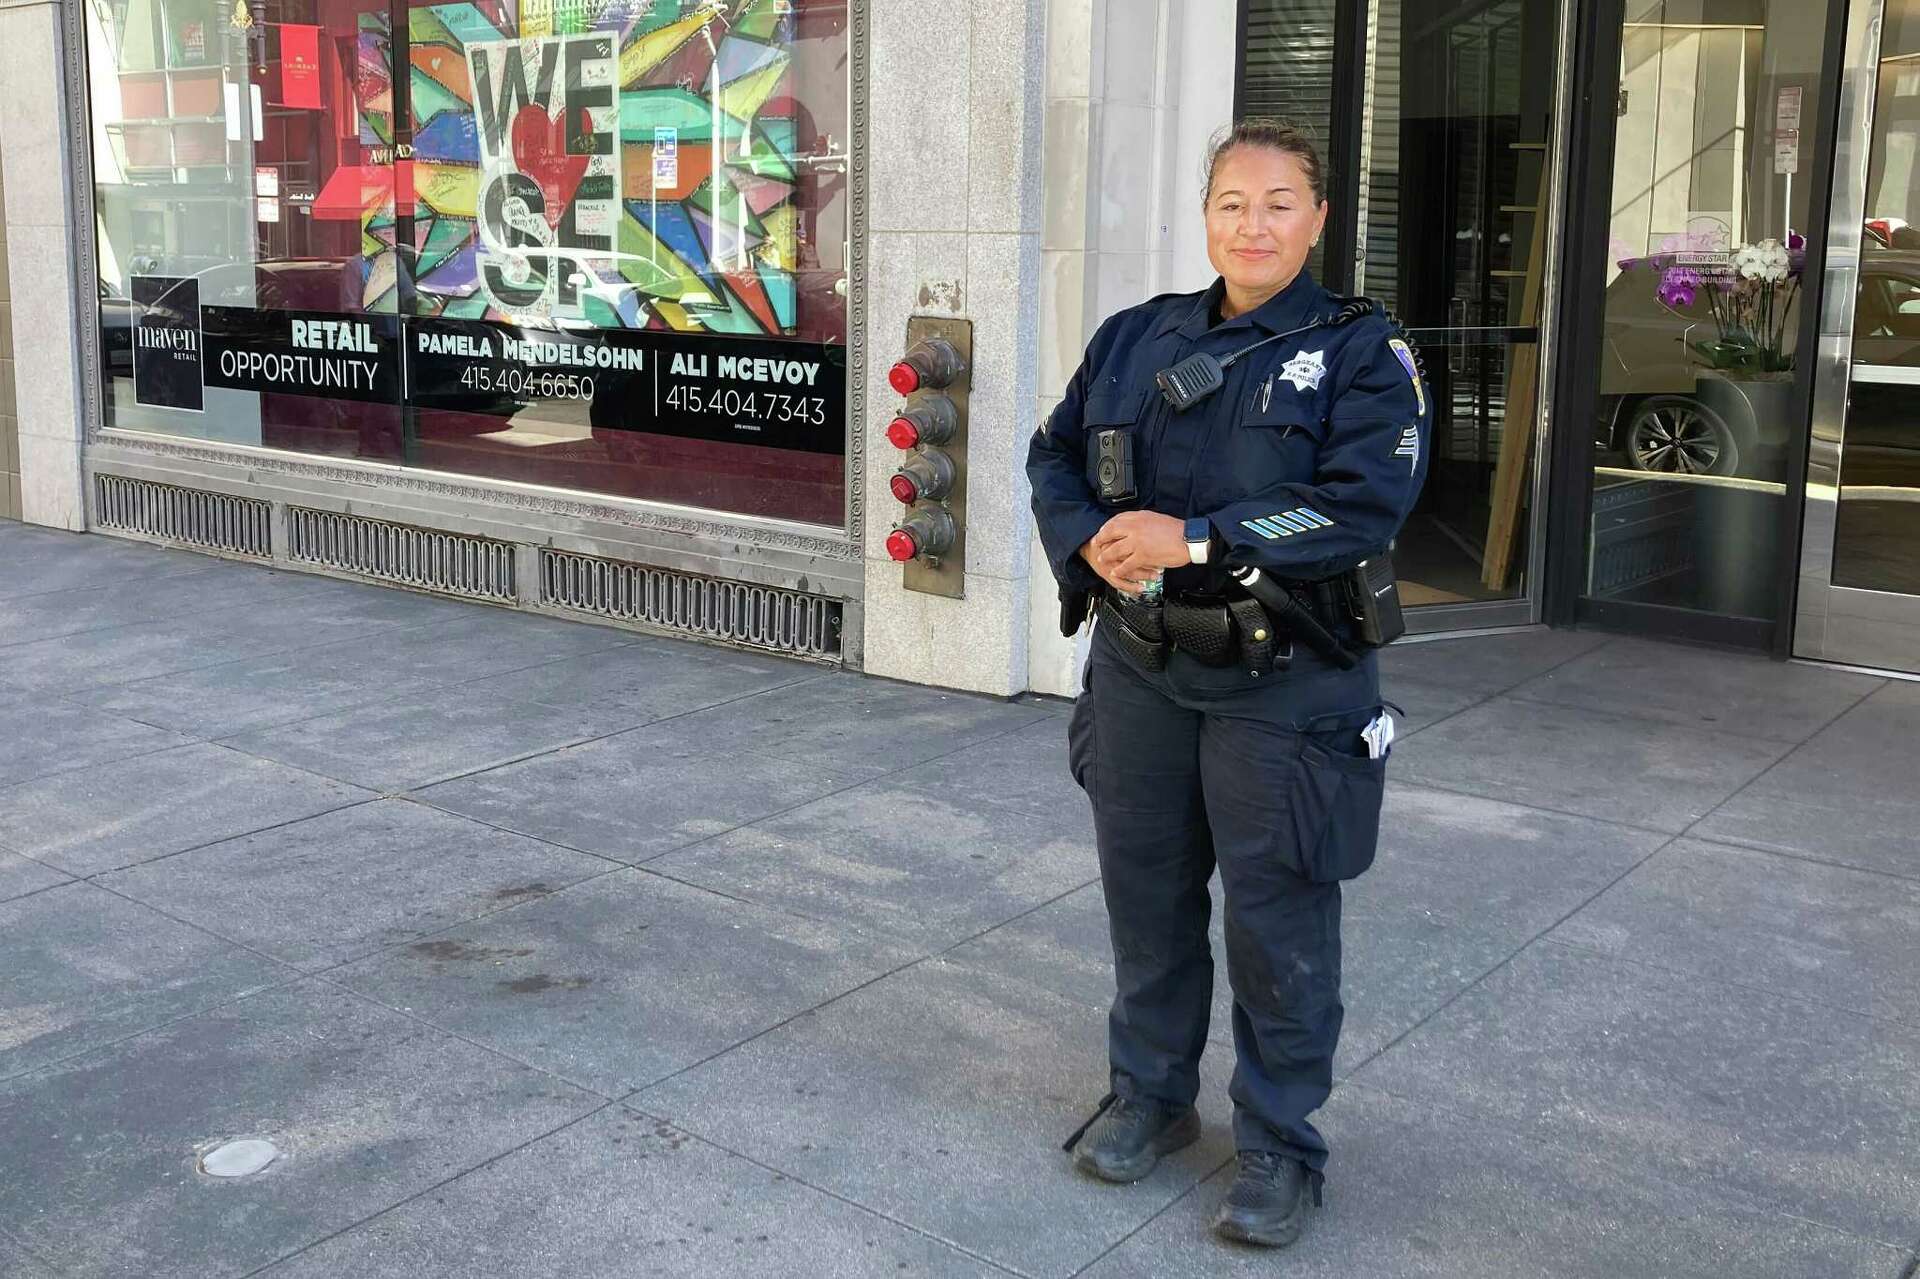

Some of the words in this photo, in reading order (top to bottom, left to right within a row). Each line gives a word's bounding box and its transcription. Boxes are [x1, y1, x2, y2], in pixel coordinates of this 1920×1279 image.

[470, 38, 613, 157] WE
[1678, 254, 1706, 263] ENERGY
[1708, 254, 1728, 263] STAR
[138, 326, 197, 351] maven
[291, 319, 378, 353] RETAIL
[418, 332, 492, 358] PAMELA
[503, 338, 643, 371] MENDELSOHN
[173, 353, 197, 362] RETAIL
[220, 350, 378, 391] OPPORTUNITY
[670, 353, 707, 377] ALI
[718, 356, 820, 386] MCEVOY
[461, 365, 594, 401] 415.404.6650
[666, 385, 825, 425] 415.404.7343
